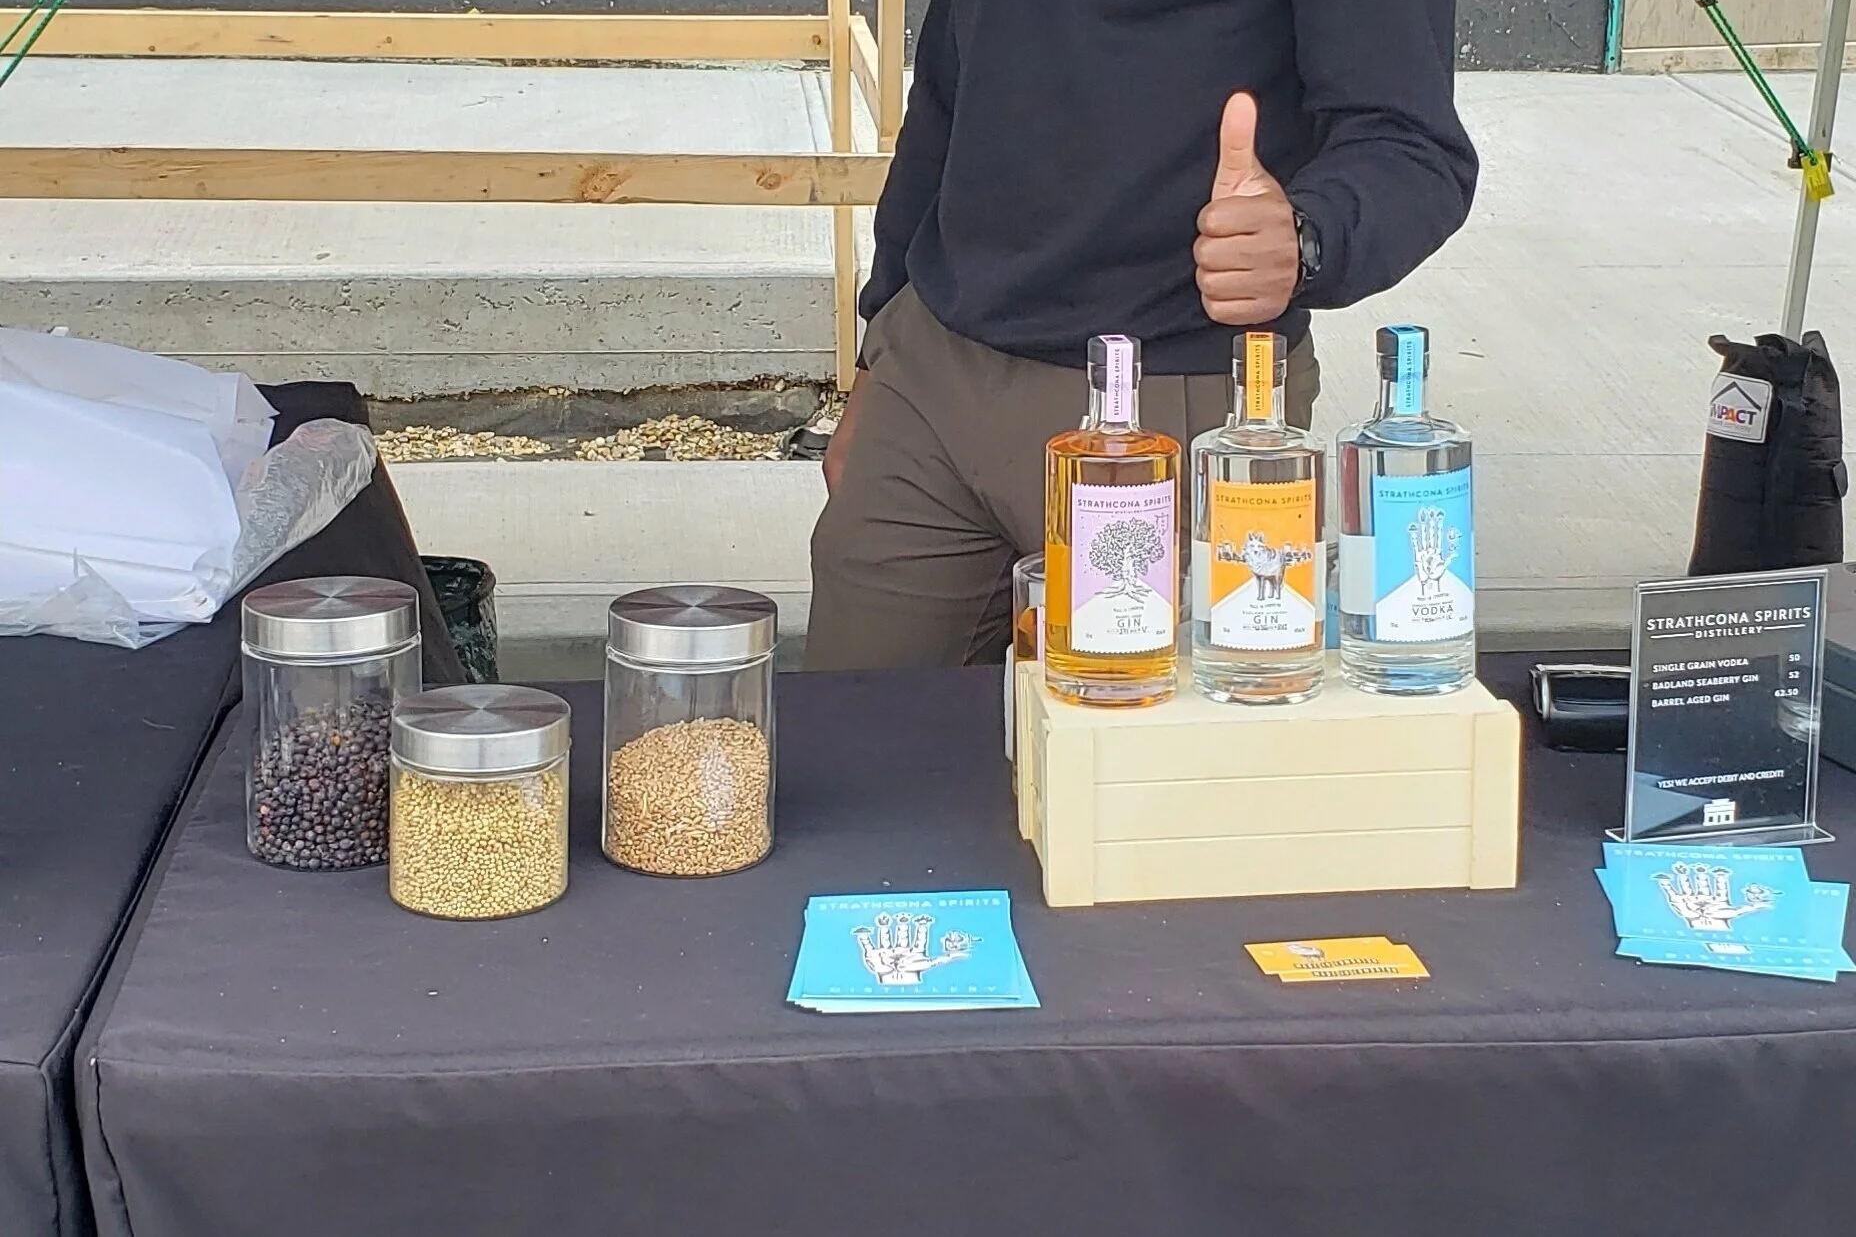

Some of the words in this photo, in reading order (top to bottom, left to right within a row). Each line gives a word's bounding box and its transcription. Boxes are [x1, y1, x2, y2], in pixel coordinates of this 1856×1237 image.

[1215, 494, 1278, 505] STRATHCONA
[1281, 494, 1312, 505] SPIRITS
[1378, 489, 1443, 498] STRATHCONA
[1077, 498, 1141, 509] STRATHCONA
[1143, 495, 1172, 507] SPIRITS
[1411, 604, 1454, 617] VODKA
[1116, 618, 1142, 629] GIN
[1253, 614, 1279, 625] GIN
[1646, 612, 1749, 631] STRATHCONA
[1754, 607, 1812, 623] SPIRITS
[1694, 626, 1763, 639] DISTILLERY
[1652, 663, 1685, 673] SINGLE
[1687, 661, 1716, 670] GRAIN
[1718, 658, 1749, 668] VODKA
[1652, 680, 1694, 690] BADLAND
[1696, 676, 1741, 687] SEABERRY
[1742, 674, 1759, 683] GIN
[1788, 671, 1800, 679] 52
[1651, 698, 1685, 708] BARREL
[1686, 696, 1711, 705] AGED
[1712, 694, 1730, 703] GIN
[1675, 778, 1688, 787] WE
[1688, 776, 1717, 786] ACCEPT
[1717, 774, 1738, 783] DEBIT
[1739, 772, 1755, 781] AND
[1614, 848, 1728, 861] STRATHCONA
[1732, 852, 1796, 862] SPIRITS
[819, 899, 932, 911] STRATHCONA
[938, 897, 1001, 908] SPIRITS
